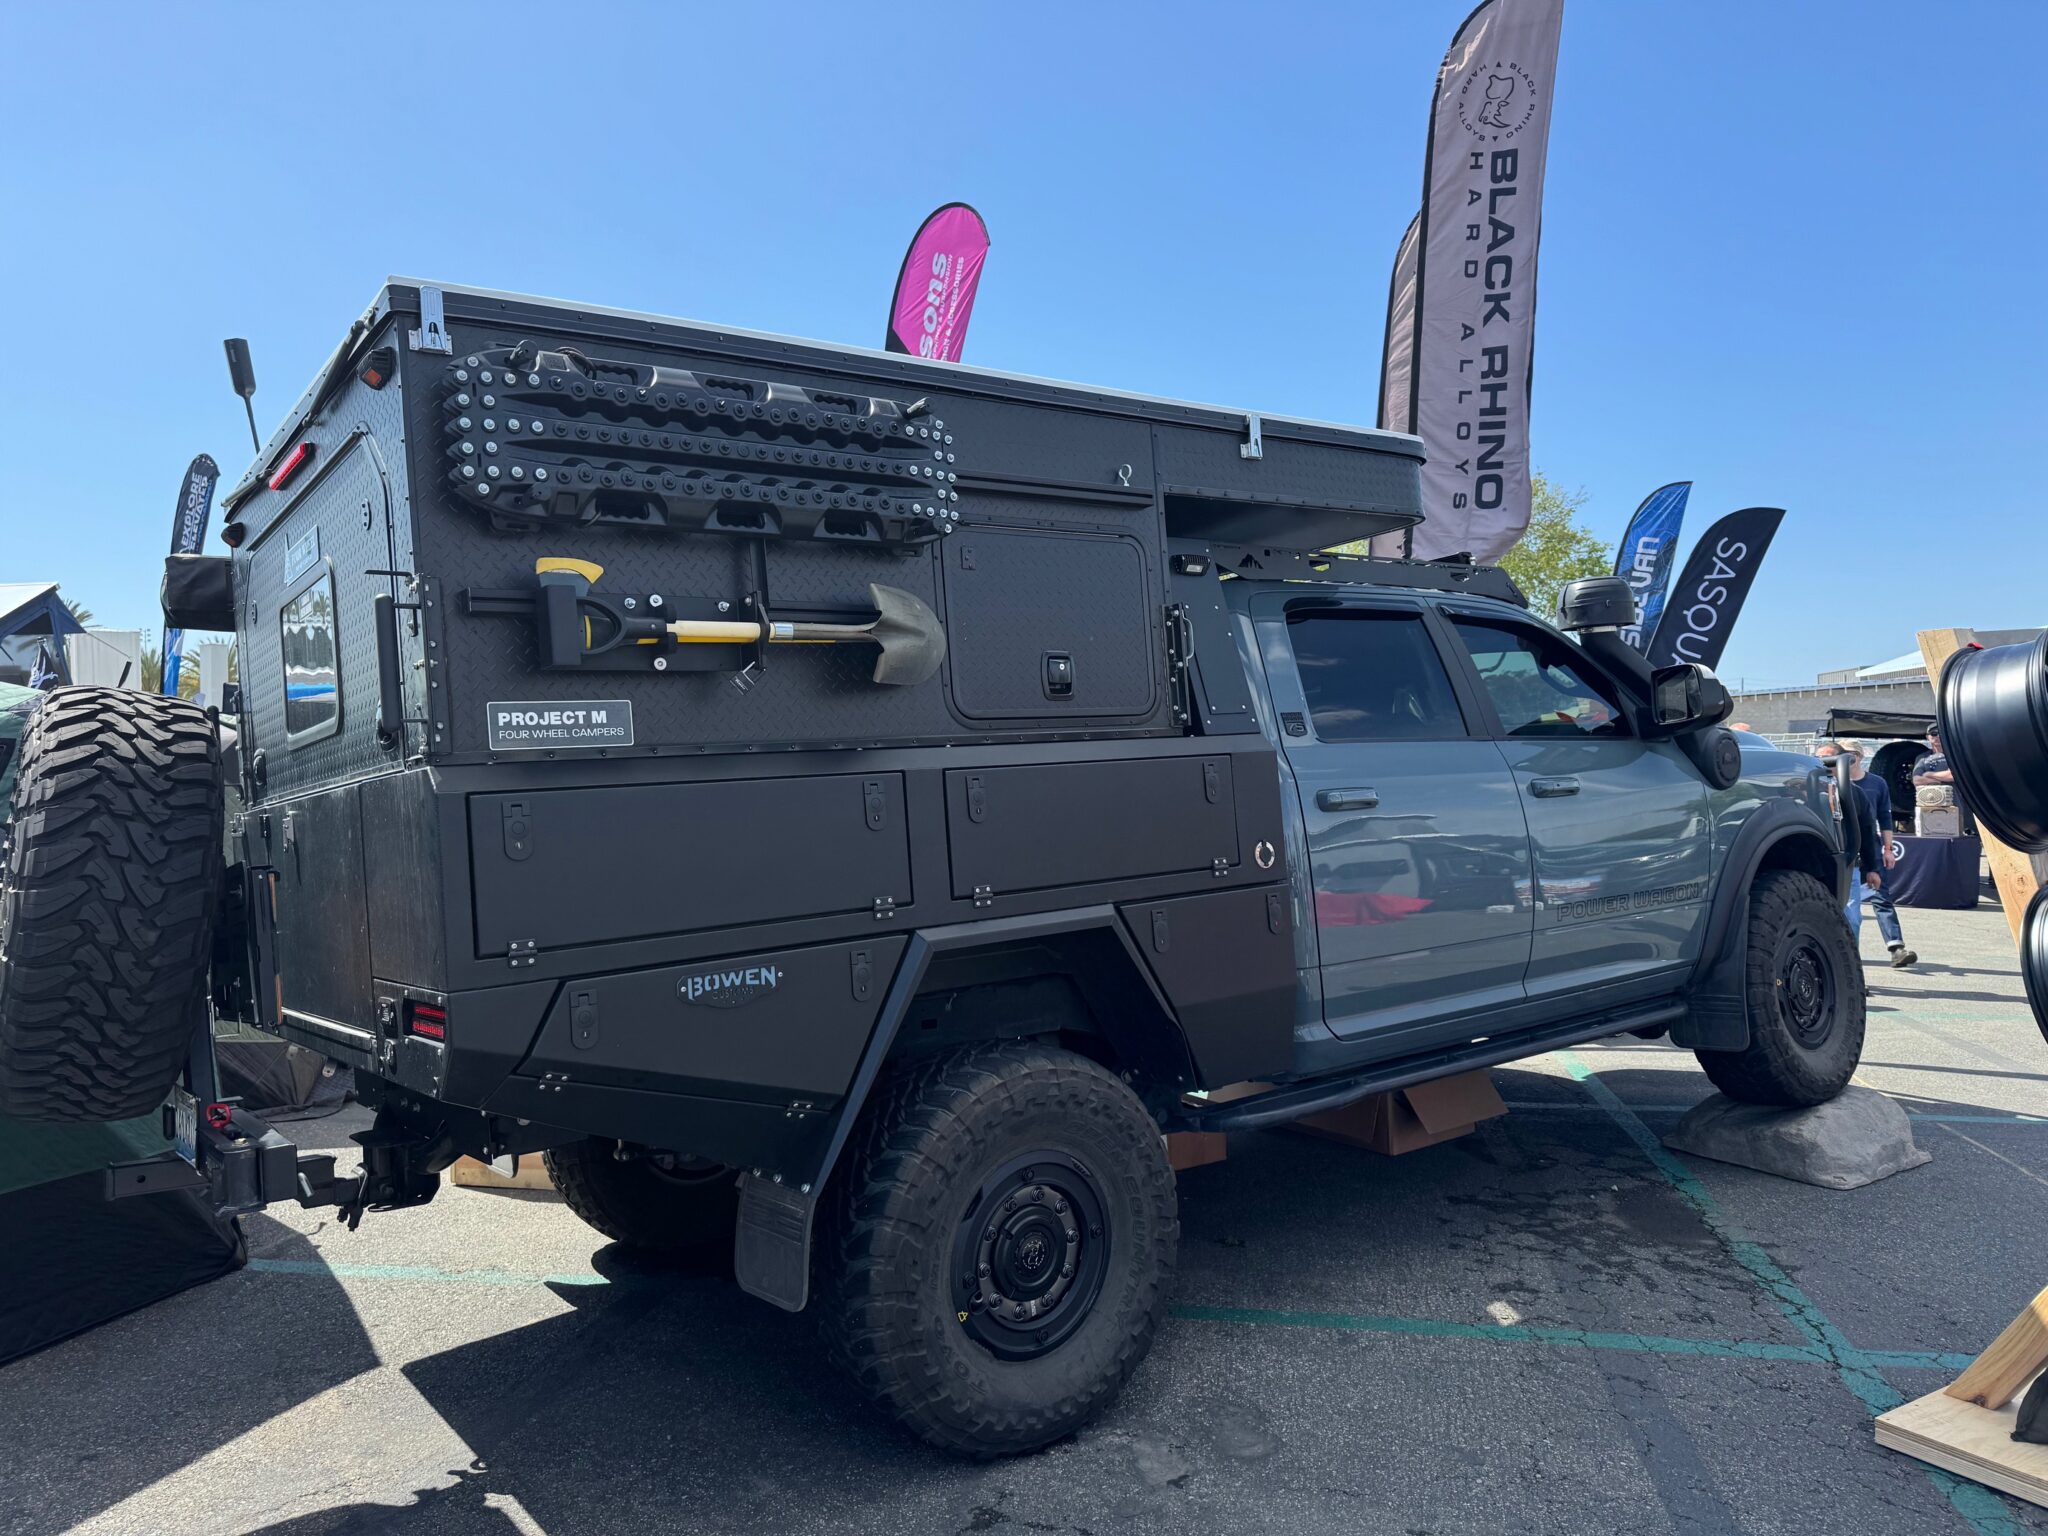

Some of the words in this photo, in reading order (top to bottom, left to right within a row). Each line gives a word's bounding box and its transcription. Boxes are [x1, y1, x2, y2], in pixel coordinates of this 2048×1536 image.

[1461, 64, 1487, 95] HARD
[1509, 62, 1536, 97] BLACK
[1459, 102, 1486, 142] ALLOYS
[1506, 103, 1536, 139] RHINO
[1464, 152, 1484, 278] HARD
[1483, 148, 1518, 328] BLACK
[947, 256, 964, 327] ACCESSORIES
[1452, 322, 1475, 510] ALLOYS
[1475, 345, 1508, 509] RHINO
[181, 472, 200, 546] EXPLORE
[497, 711, 587, 727] PROJECT
[591, 710, 607, 724] M
[499, 729, 530, 740] FOUR
[532, 728, 570, 739] WHEEL
[571, 727, 625, 737] CAMPERS
[1556, 893, 1630, 922] POWER
[1633, 882, 1700, 909] WAGON
[687, 965, 777, 1001] BOWEN
